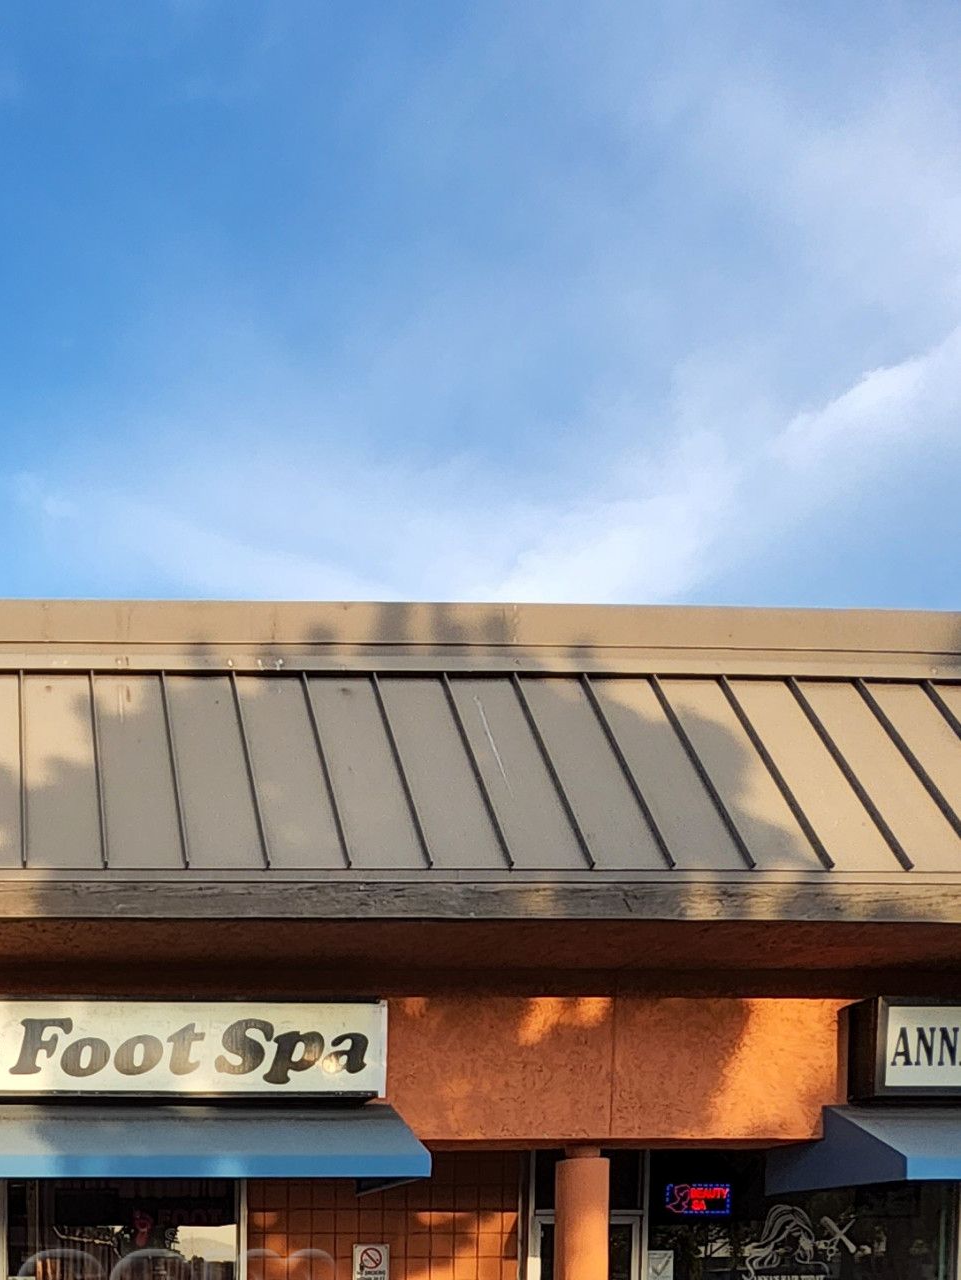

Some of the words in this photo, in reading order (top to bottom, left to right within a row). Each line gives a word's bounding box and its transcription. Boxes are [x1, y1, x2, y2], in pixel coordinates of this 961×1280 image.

[9, 1017, 206, 1077] Foot
[214, 1018, 370, 1084] Spa
[890, 1026, 961, 1067] ANN
[689, 1187, 729, 1199] BEAUTY
